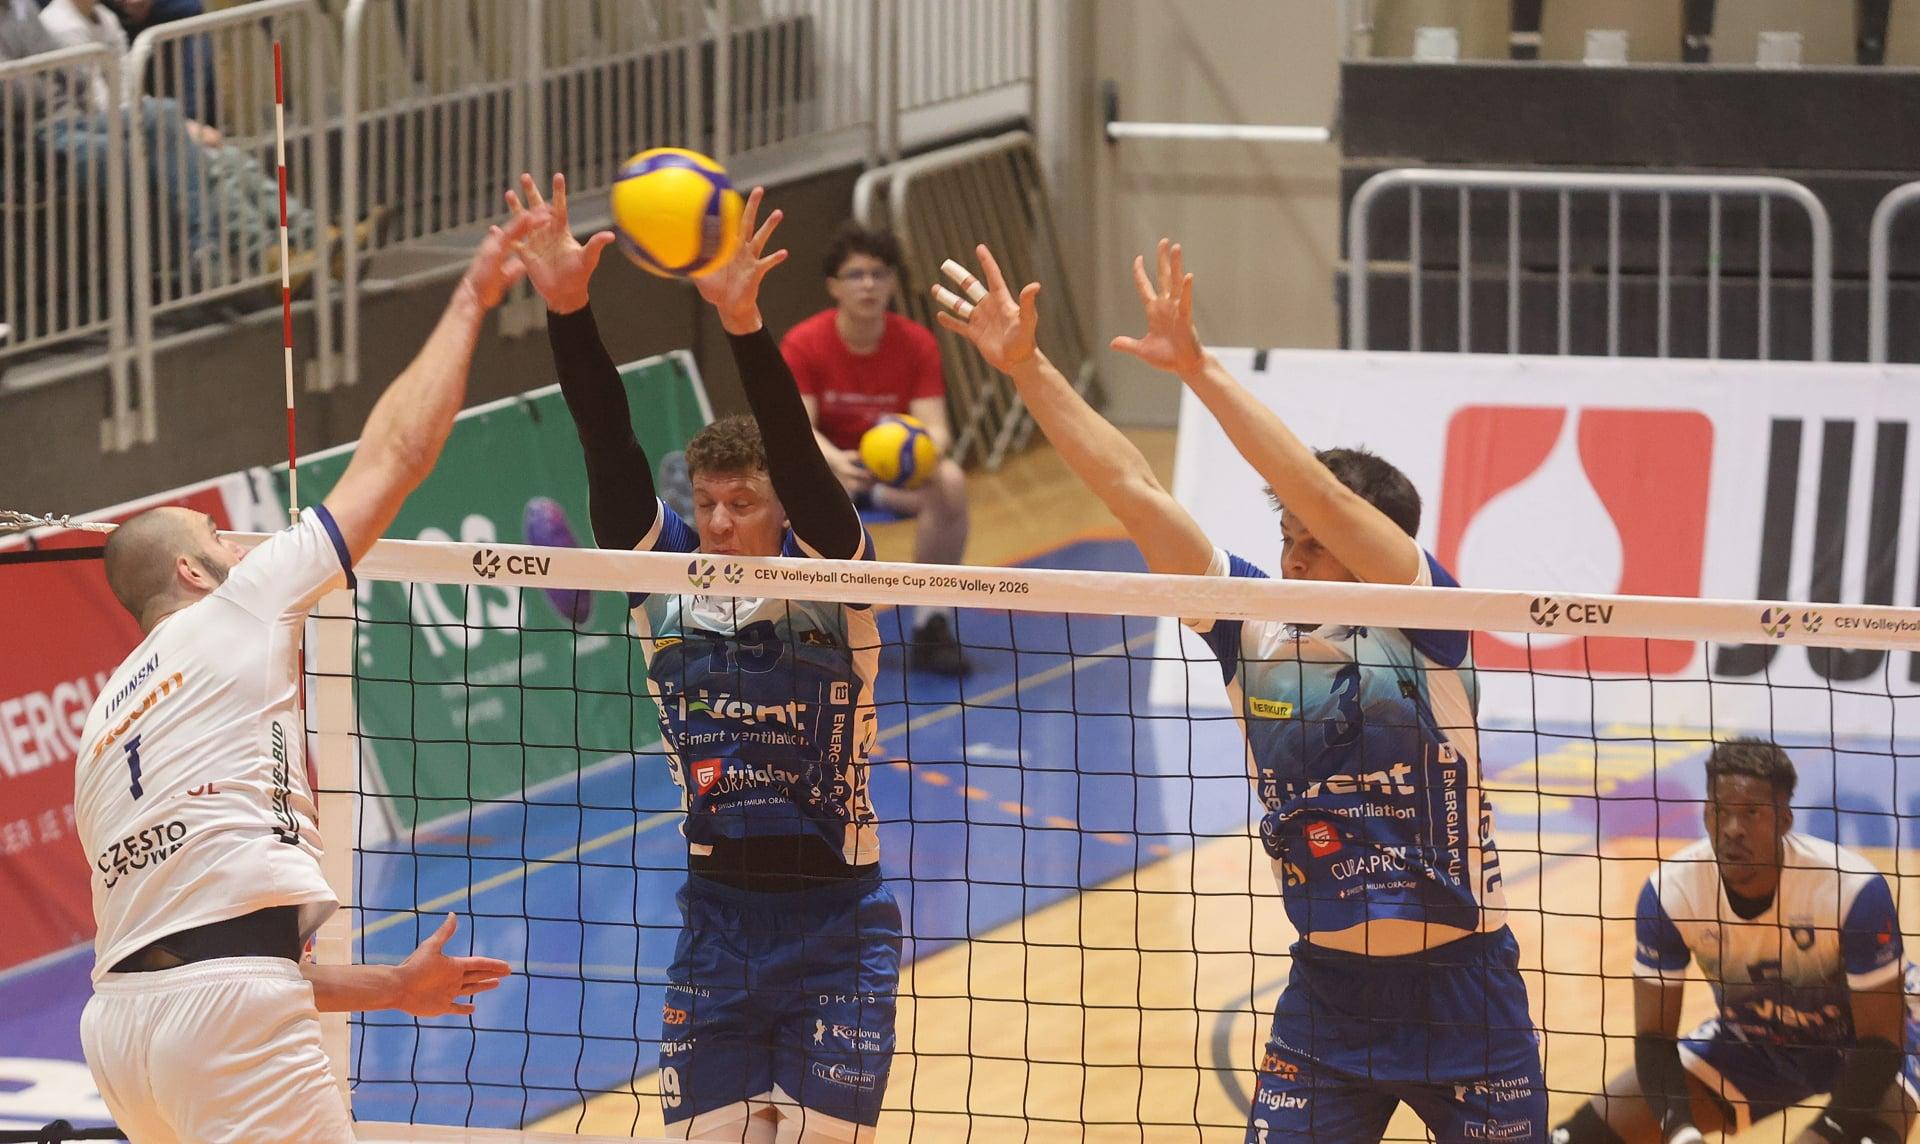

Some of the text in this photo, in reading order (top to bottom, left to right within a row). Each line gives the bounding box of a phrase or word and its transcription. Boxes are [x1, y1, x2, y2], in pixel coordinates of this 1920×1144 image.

[507, 555, 550, 576] CEV
[754, 569, 1029, 594] CEV Volleyball Challenge Cup 2026 Volley 2026
[1566, 603, 1613, 624] CEV
[1834, 616, 1860, 629] CEV
[1443, 769, 1462, 887] ENERGIJA PLUS
[1258, 1087, 1308, 1111] triglav
